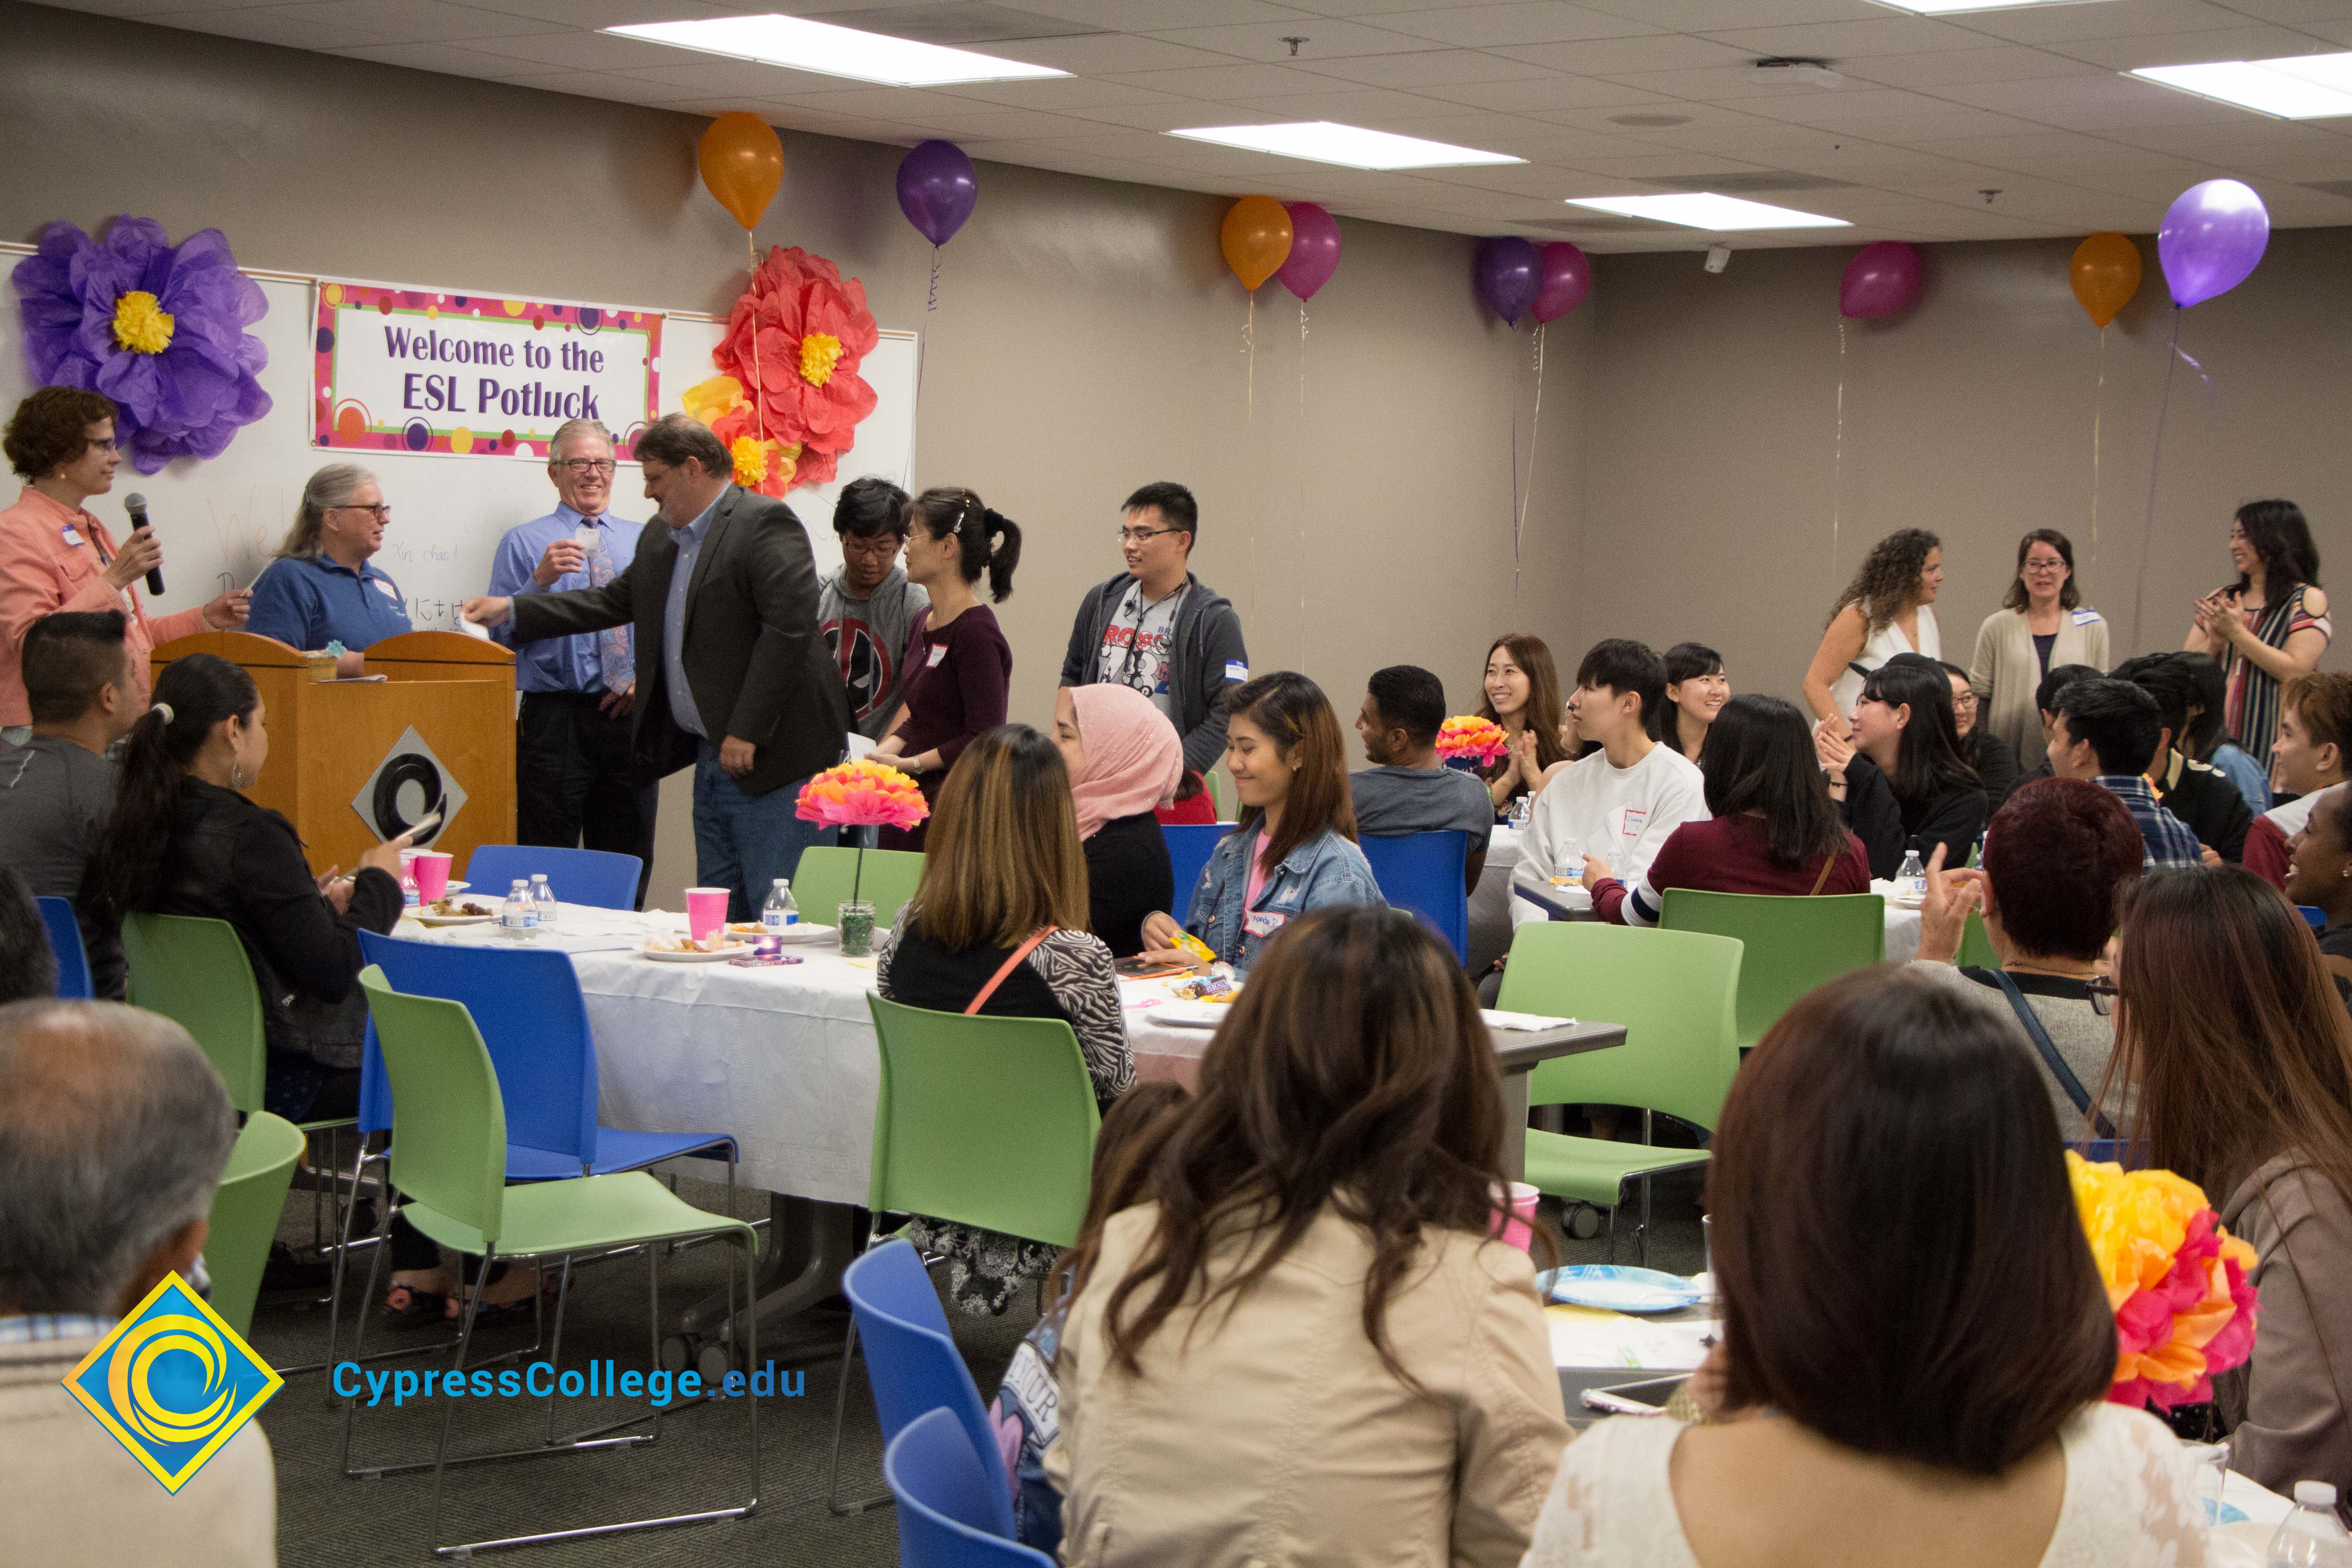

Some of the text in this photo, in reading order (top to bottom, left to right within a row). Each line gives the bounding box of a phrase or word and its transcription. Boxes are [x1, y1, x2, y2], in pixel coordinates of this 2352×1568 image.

[384, 326, 605, 373] Welcome to the
[403, 372, 599, 420] ESL Potluck
